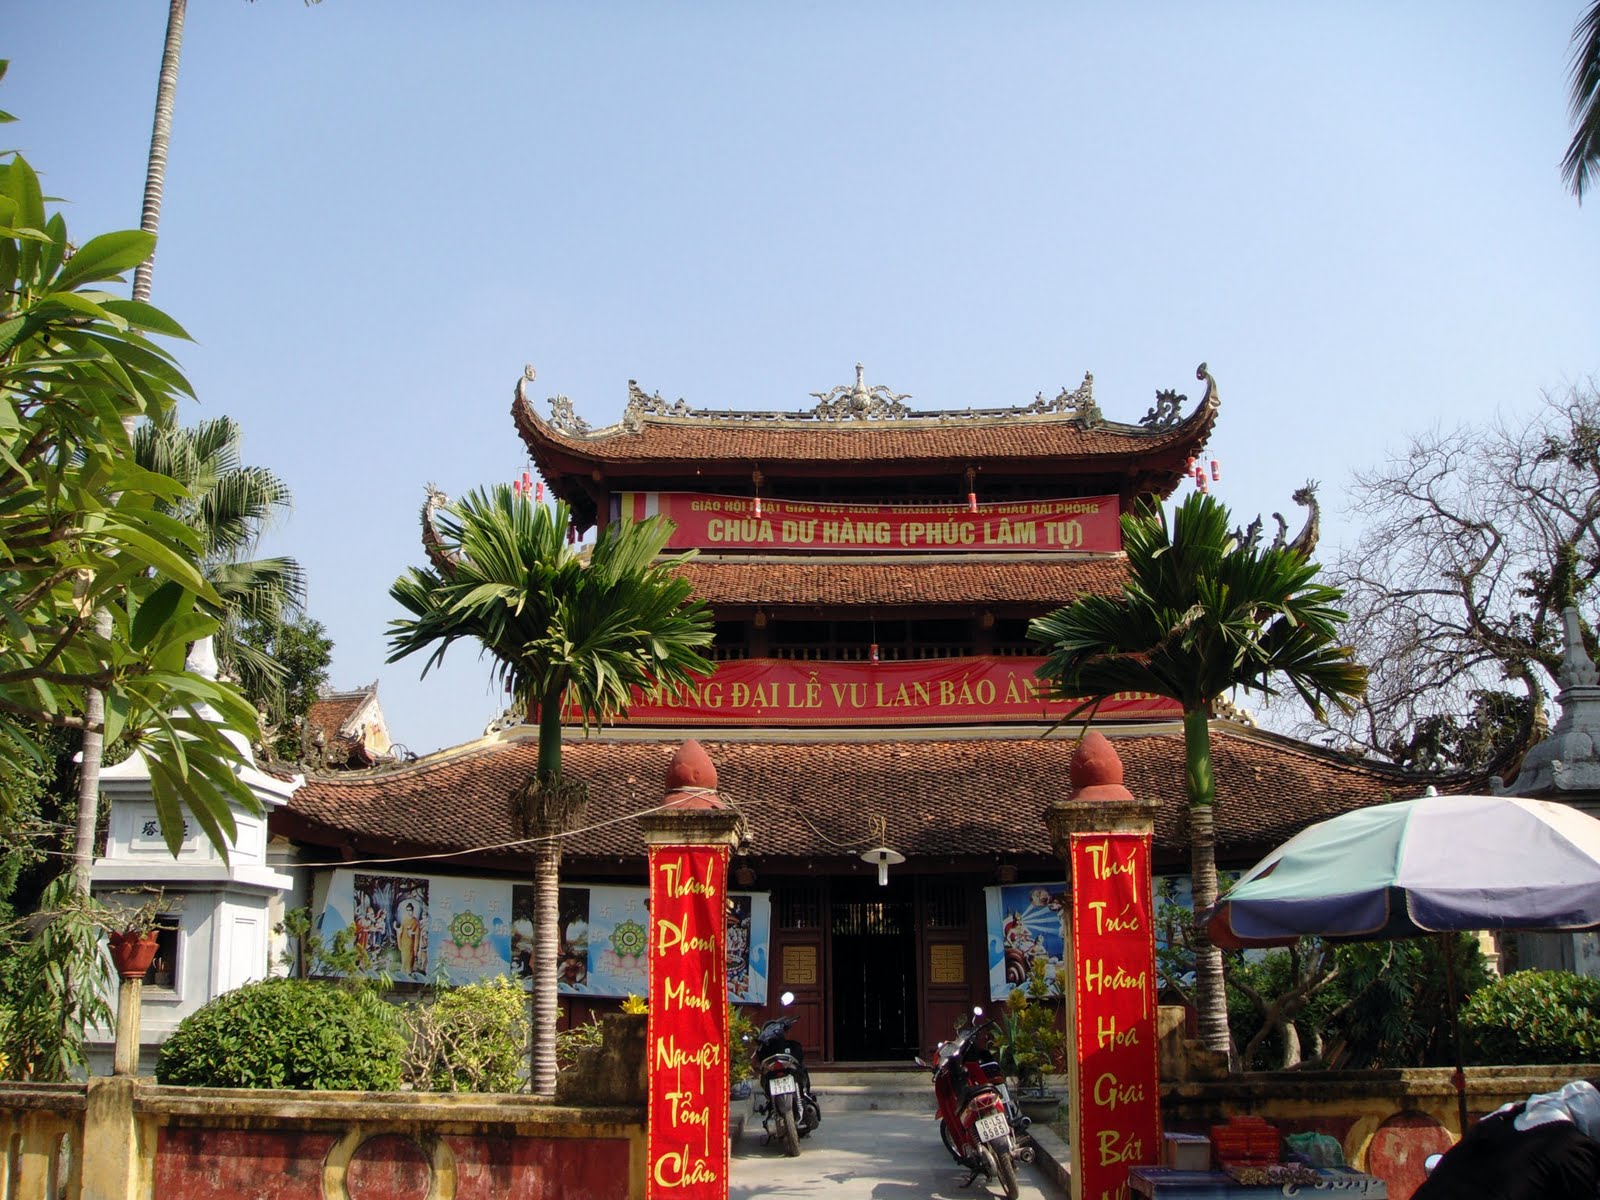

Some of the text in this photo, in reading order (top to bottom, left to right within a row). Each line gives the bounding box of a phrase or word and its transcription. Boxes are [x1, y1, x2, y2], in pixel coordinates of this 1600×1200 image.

[691, 499, 721, 511] GIÁO
[725, 500, 746, 513] HỘI
[1055, 501, 1099, 514] PHÒNG
[708, 514, 1083, 549] CHÙA DƯ HÀNG (PHÚC LÂM TỰ)
[731, 682, 780, 714] ĐẠI
[788, 671, 823, 708] LỄ
[830, 682, 868, 708] VU
[875, 681, 930, 707] LAN
[939, 672, 996, 705] BÁO
[1004, 671, 1041, 704] ÂN
[1088, 901, 1140, 935] Trúc
[1085, 958, 1147, 1020] Hoàng
[654, 856, 721, 1188] Thanh Phong Minh Nguyệt Tổng Chân
[1097, 1015, 1140, 1052] Hoa
[1094, 1072, 1145, 1111] Giai
[983, 1125, 1005, 1140] 9585
[1096, 1129, 1143, 1167] Bát
